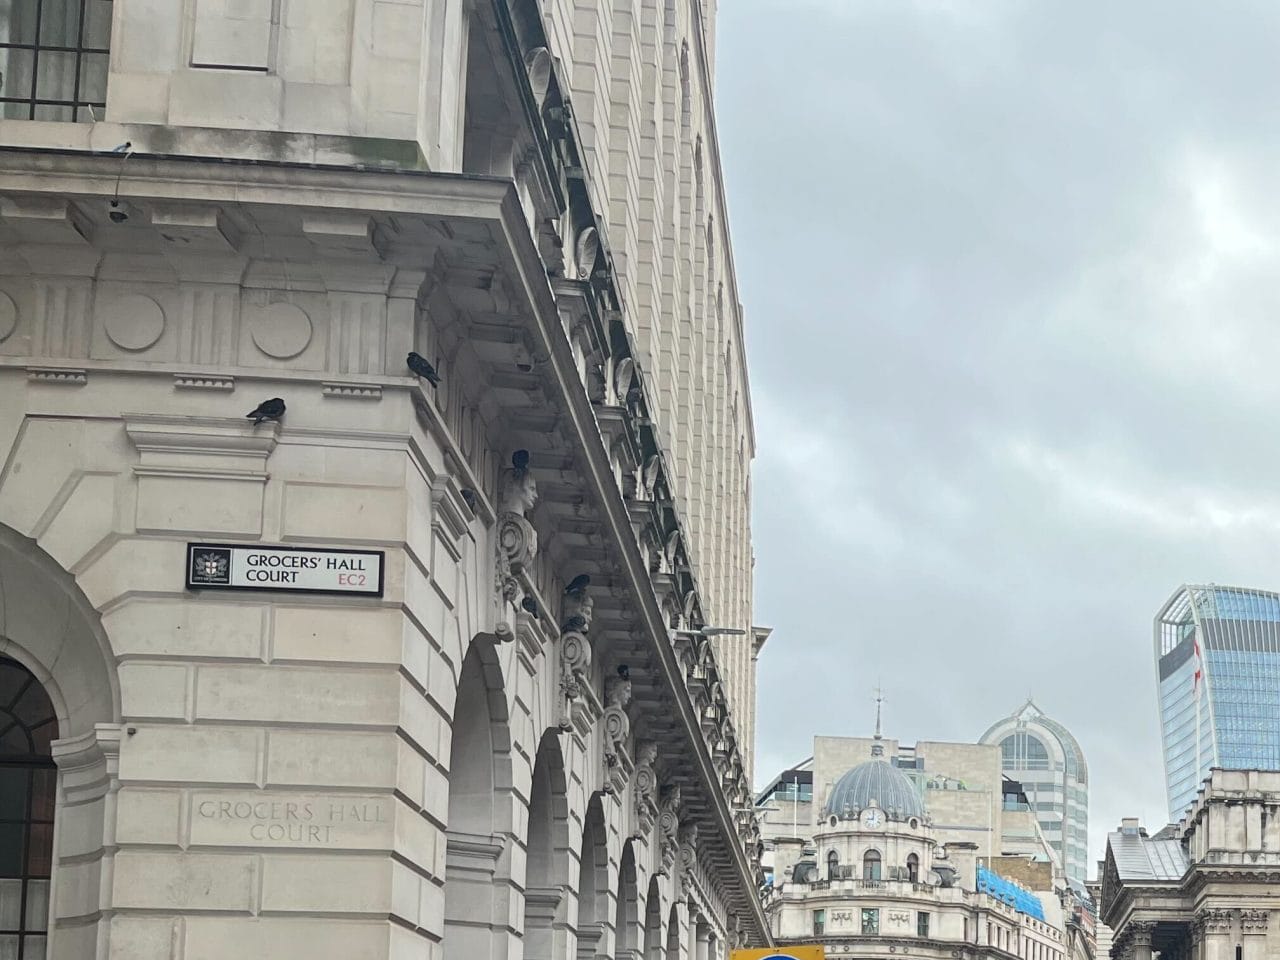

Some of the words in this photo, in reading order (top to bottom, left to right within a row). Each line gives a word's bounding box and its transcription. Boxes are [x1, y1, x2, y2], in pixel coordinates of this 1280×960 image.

[246, 554, 321, 569] GROCERS'
[326, 557, 366, 571] HALL
[246, 569, 299, 583] COURT
[338, 573, 366, 586] EC2
[199, 800, 313, 821] GROCERS
[329, 803, 385, 823] HALL
